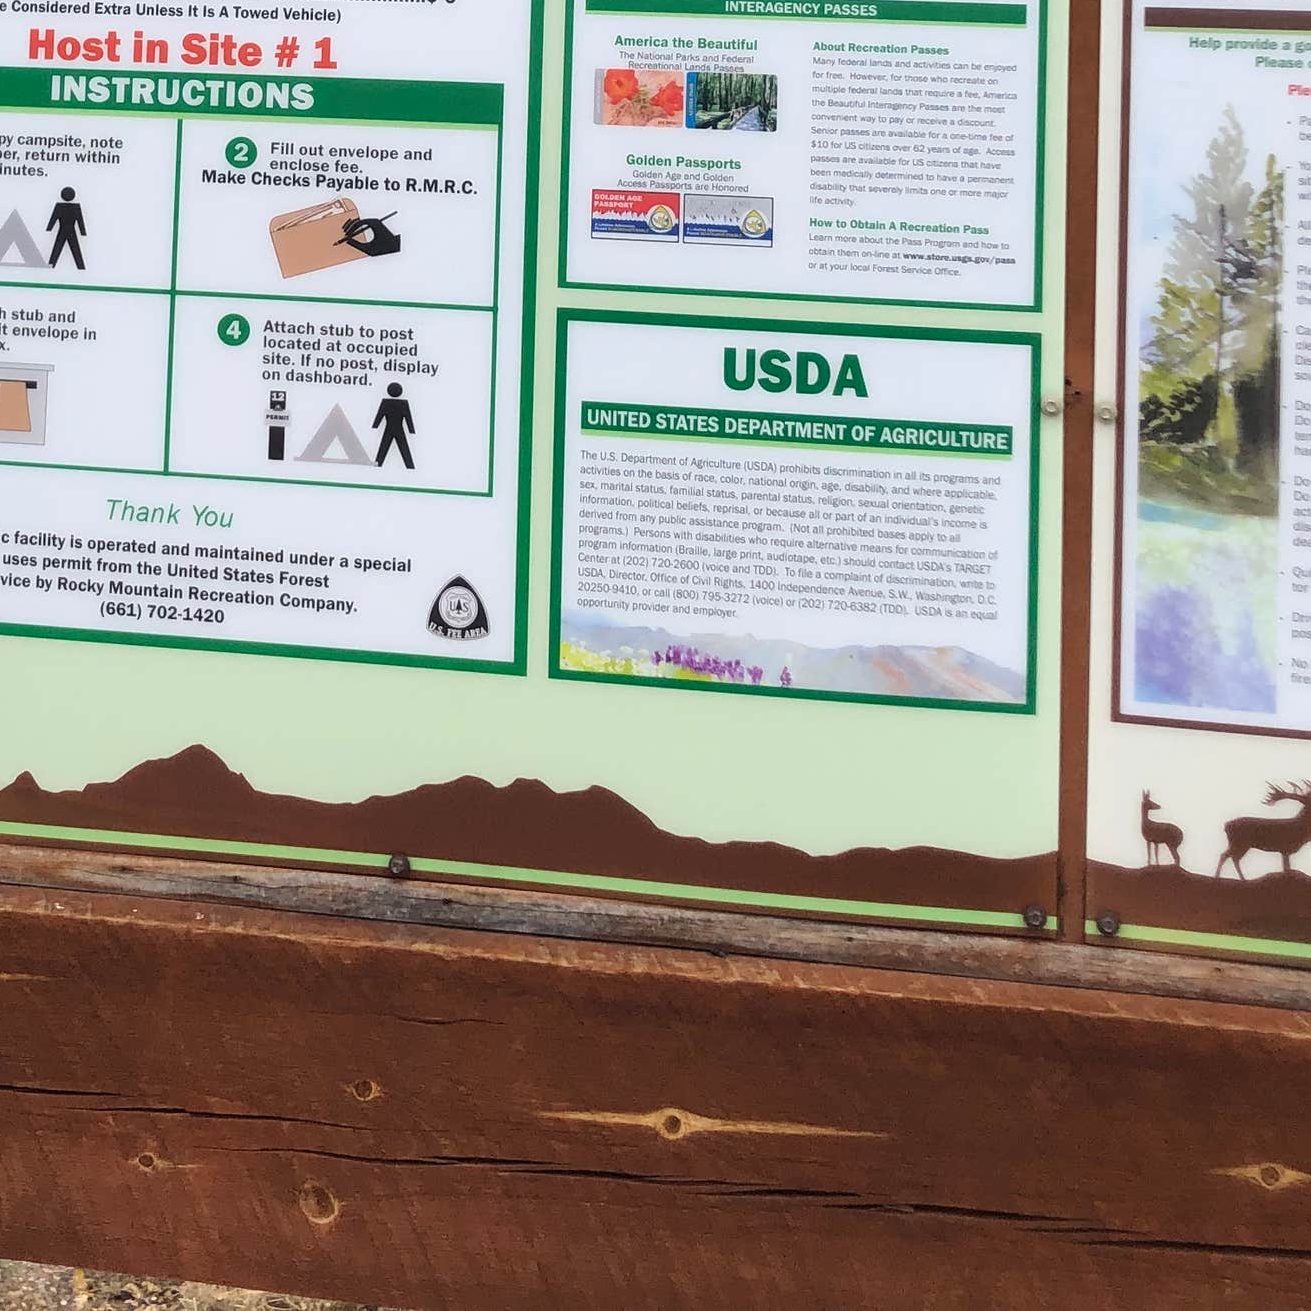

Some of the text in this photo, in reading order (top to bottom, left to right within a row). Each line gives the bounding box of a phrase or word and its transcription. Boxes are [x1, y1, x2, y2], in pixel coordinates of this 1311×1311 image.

[11, 0, 89, 13] Considered
[95, 2, 130, 14] Extra
[136, 3, 182, 16] Unless
[188, 5, 198, 17] It
[203, 5, 214, 17] Is
[219, 6, 228, 17] A
[233, 6, 278, 19] Towed
[283, 7, 340, 24] Vehicle)
[725, 1, 876, 15] INTERAGENCY PASSES
[29, 29, 336, 68] Host in Site # 1
[614, 35, 757, 50] America the Beautiful
[813, 42, 948, 55] About Recreation Passes
[1189, 37, 1221, 50] Help
[1225, 39, 1278, 51] provide
[51, 75, 313, 109] INSTRUCTIONS
[17, 135, 85, 149] campsite,
[89, 137, 122, 149] note
[25, 149, 69, 161] return
[75, 150, 119, 163] within
[234, 143, 248, 161] 2
[271, 142, 431, 161] Fill out envelope and
[270, 159, 362, 173] enclose fee.
[626, 154, 741, 170] Golden Passports
[202, 169, 476, 194] Make Checks Payable to R.M.R.C.
[11, 309, 43, 321] stub
[48, 311, 75, 322] and
[12, 325, 78, 341] envelope
[84, 327, 96, 340] in
[226, 320, 241, 338] 4
[263, 320, 413, 341] Attach stub to post
[263, 336, 417, 356] located at occupied
[263, 352, 438, 376] site. If no post, display
[724, 347, 868, 397] USDA
[262, 369, 371, 385] on dashboard.
[587, 409, 1008, 449] UNITED STATES DEPARTMENT OF AGRICULTURE
[107, 499, 233, 527] Thank You
[100, 601, 224, 623] (661) 702-1420
